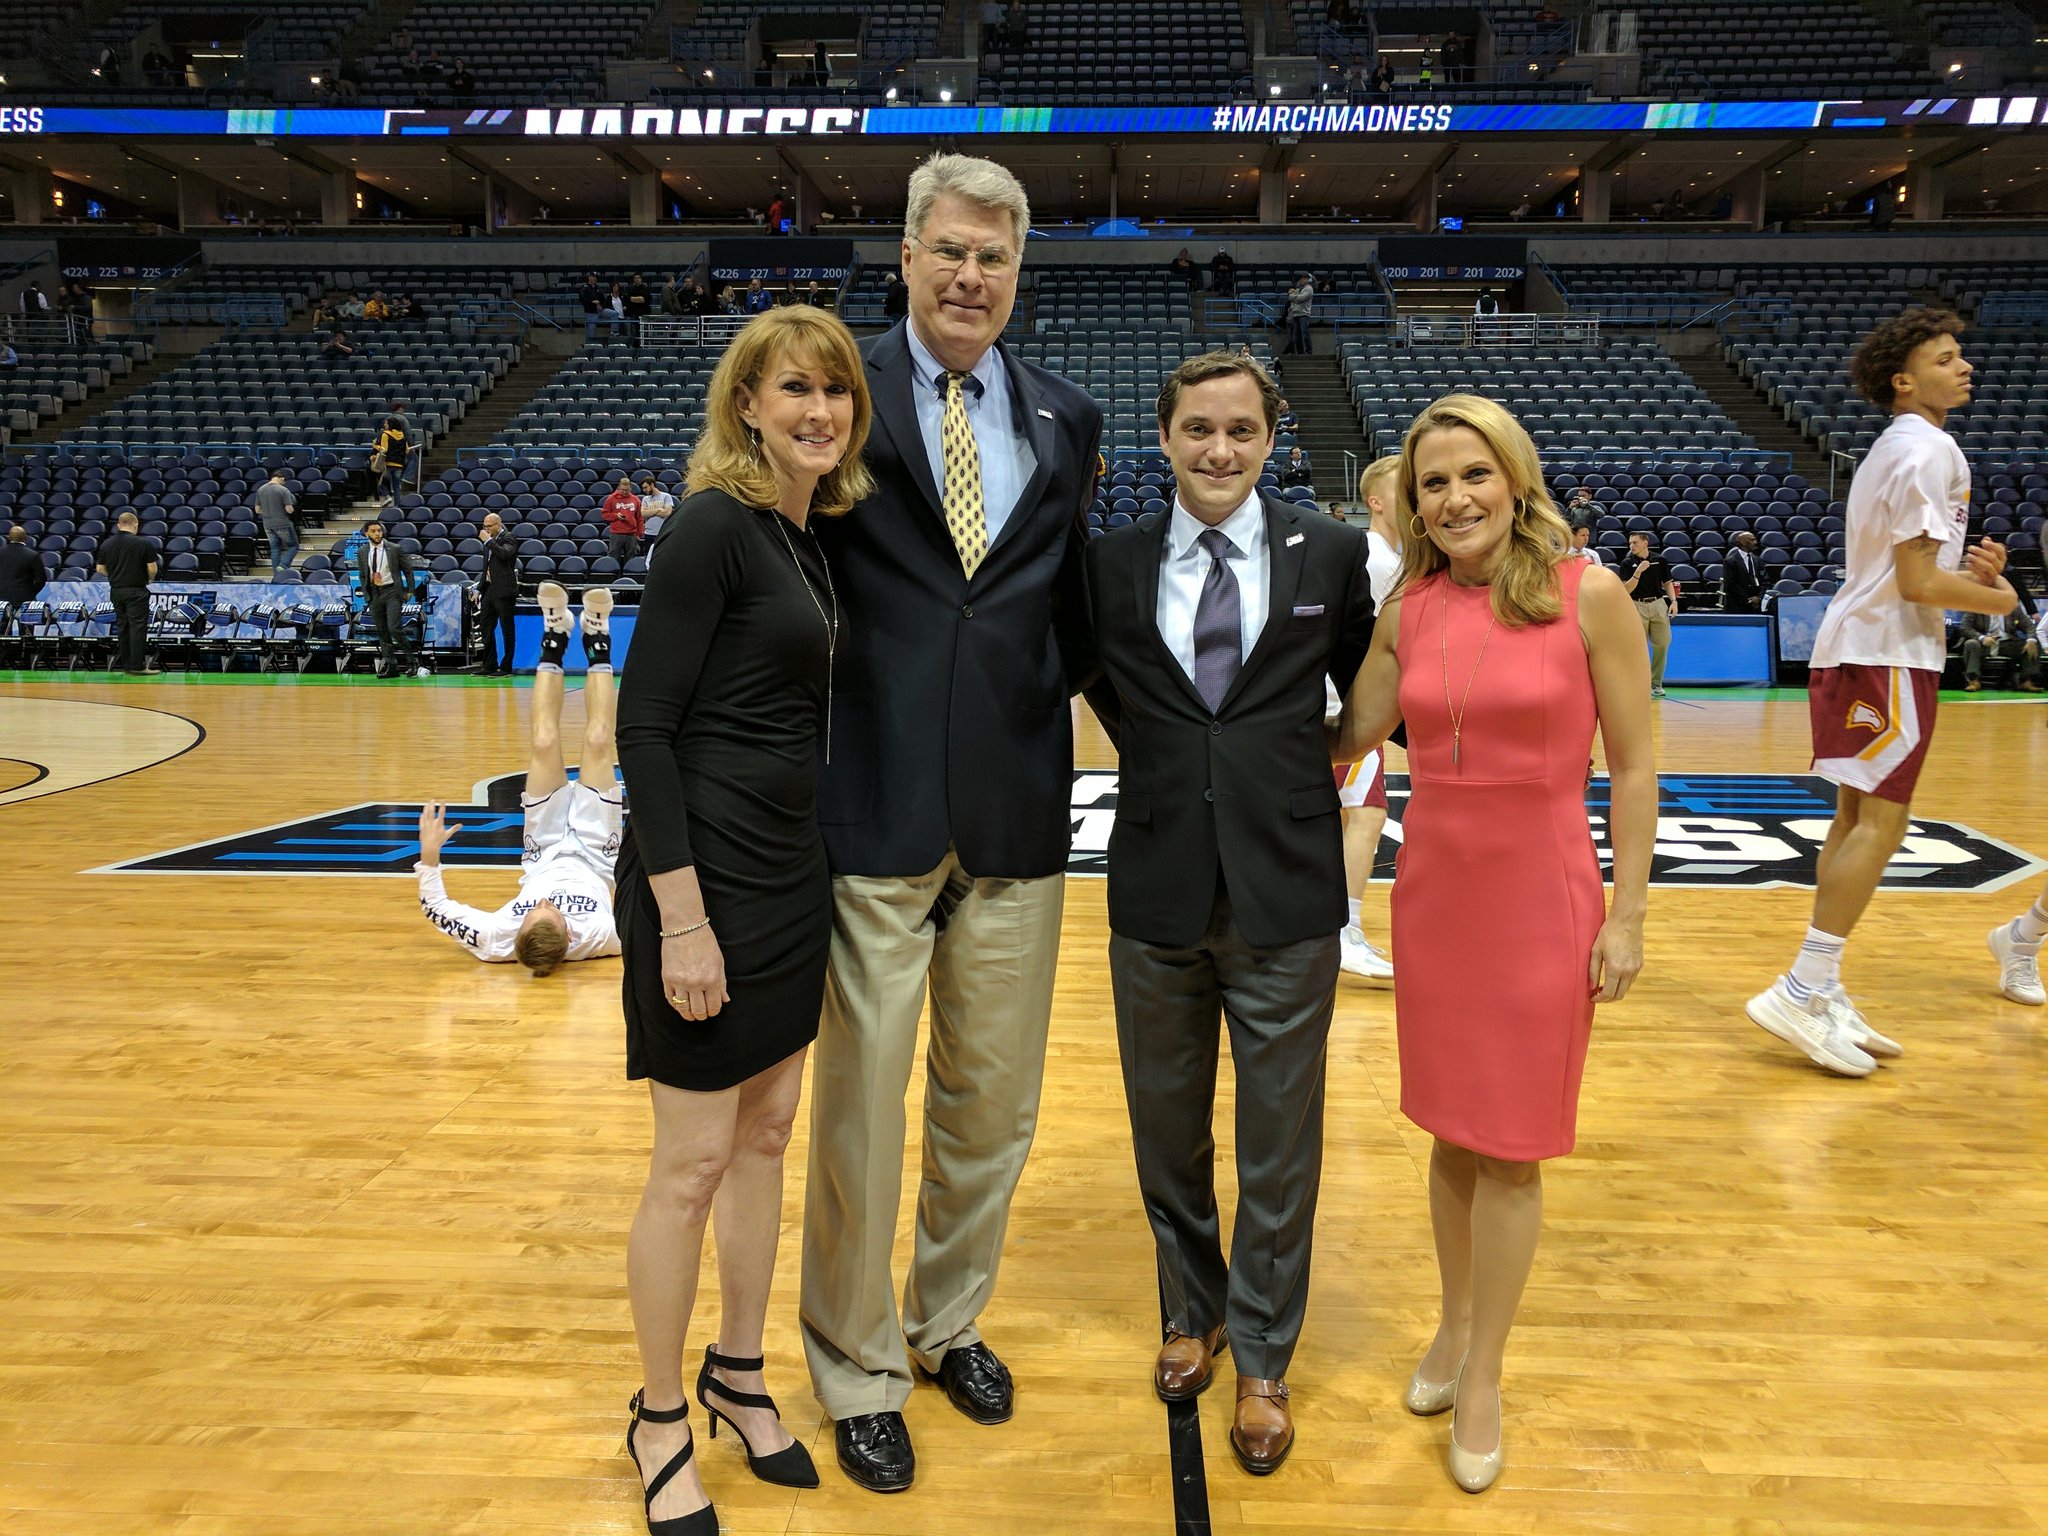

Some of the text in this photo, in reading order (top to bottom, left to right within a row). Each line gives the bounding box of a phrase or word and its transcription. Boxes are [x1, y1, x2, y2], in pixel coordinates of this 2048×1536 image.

[1212, 105, 1453, 132] #MARCHMADNESS
[70, 266, 89, 277] 224
[99, 267, 119, 277] 225
[142, 267, 161, 278] 225
[720, 268, 739, 279] 226
[750, 268, 769, 279] 227
[794, 268, 812, 279] 227
[822, 268, 841, 279] 200
[1388, 267, 1408, 278] 200
[1420, 267, 1440, 278] 201
[1464, 267, 1483, 278] 201
[1495, 267, 1516, 278] 202
